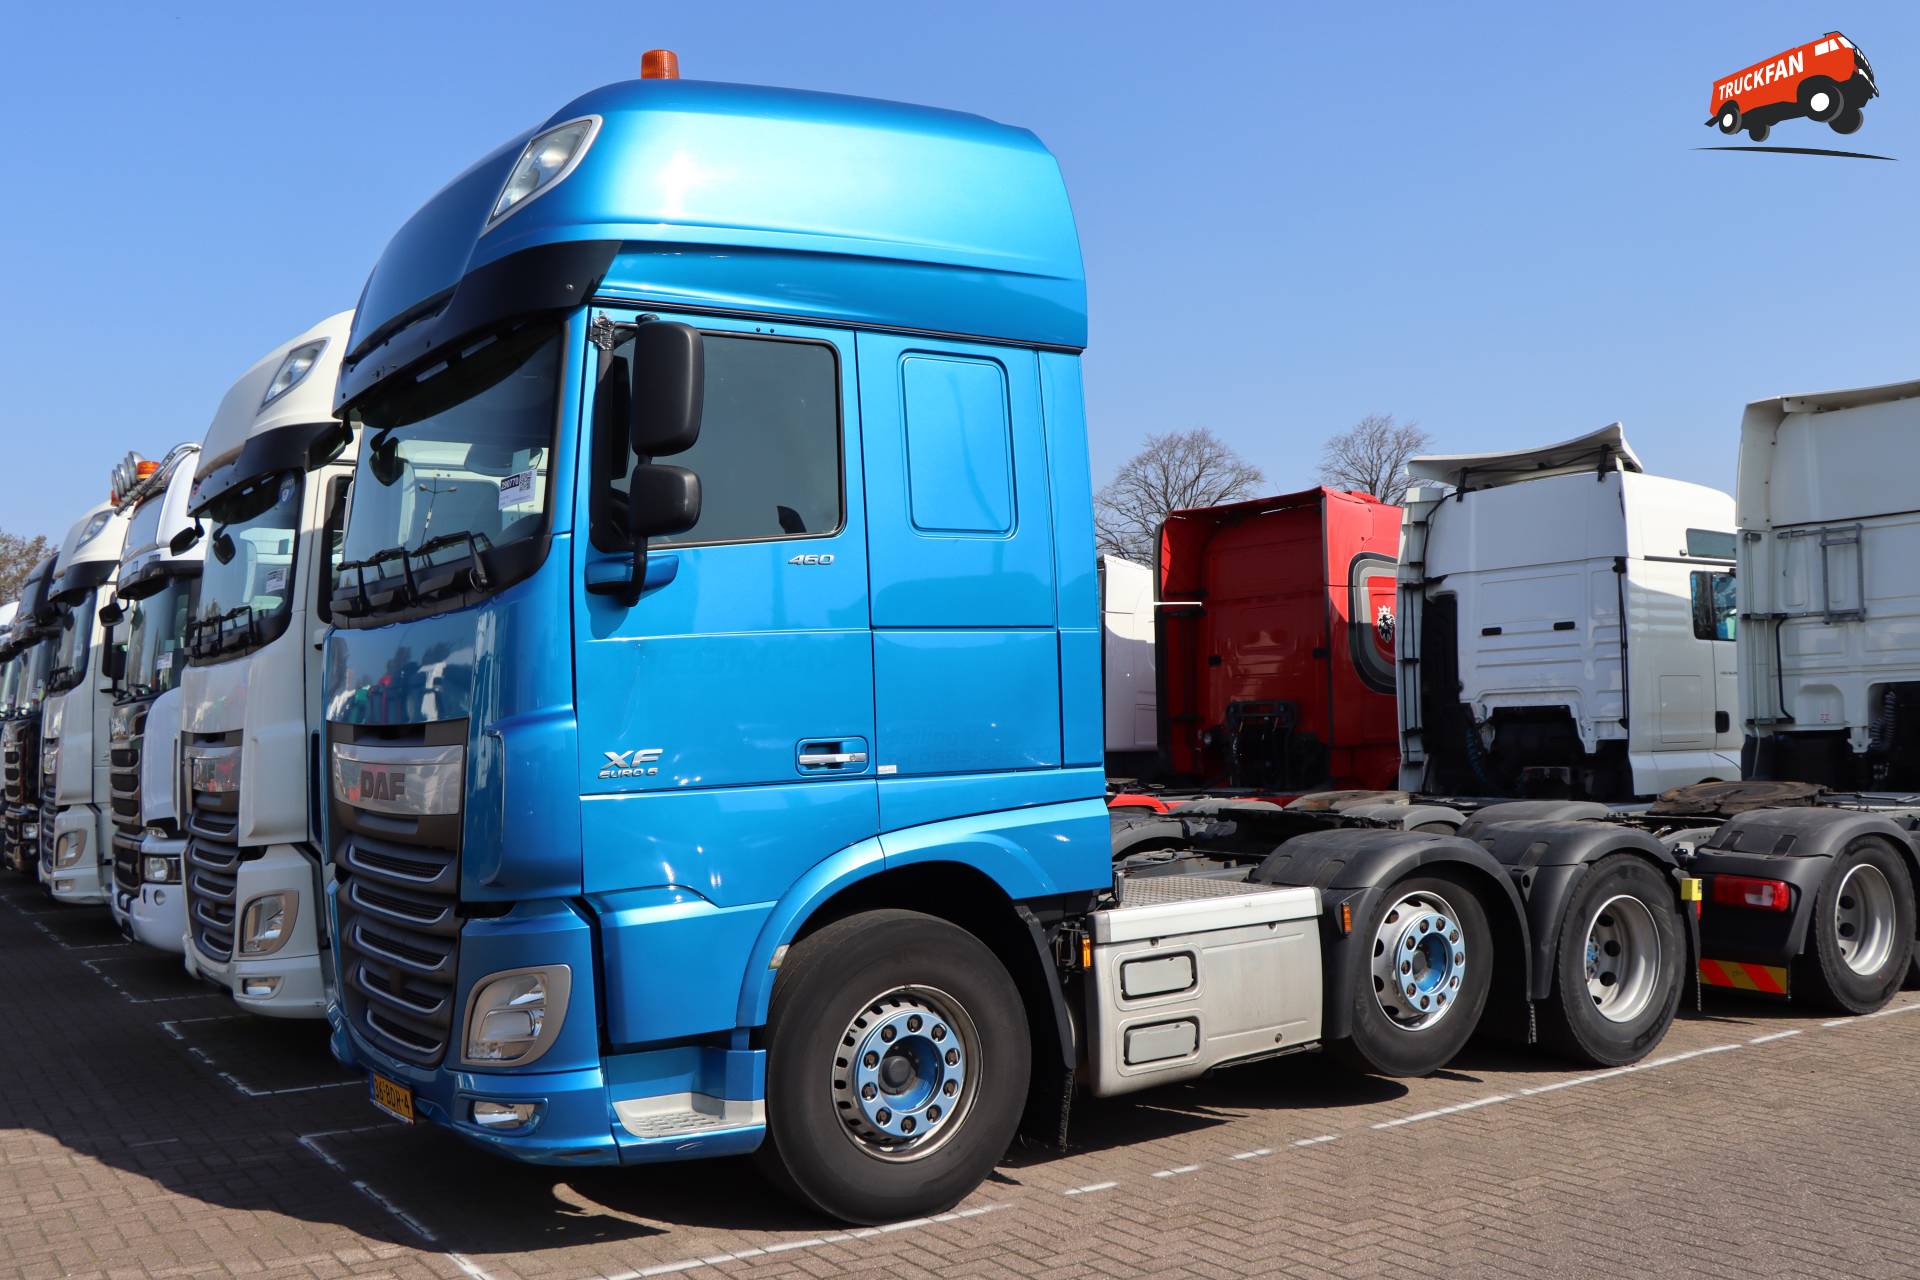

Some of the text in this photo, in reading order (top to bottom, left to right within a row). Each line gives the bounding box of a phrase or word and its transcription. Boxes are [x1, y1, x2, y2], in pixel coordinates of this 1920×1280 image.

[788, 554, 834, 565] 460
[600, 748, 664, 770] XF
[598, 767, 659, 779] EURO 6
[360, 770, 406, 801] DAF
